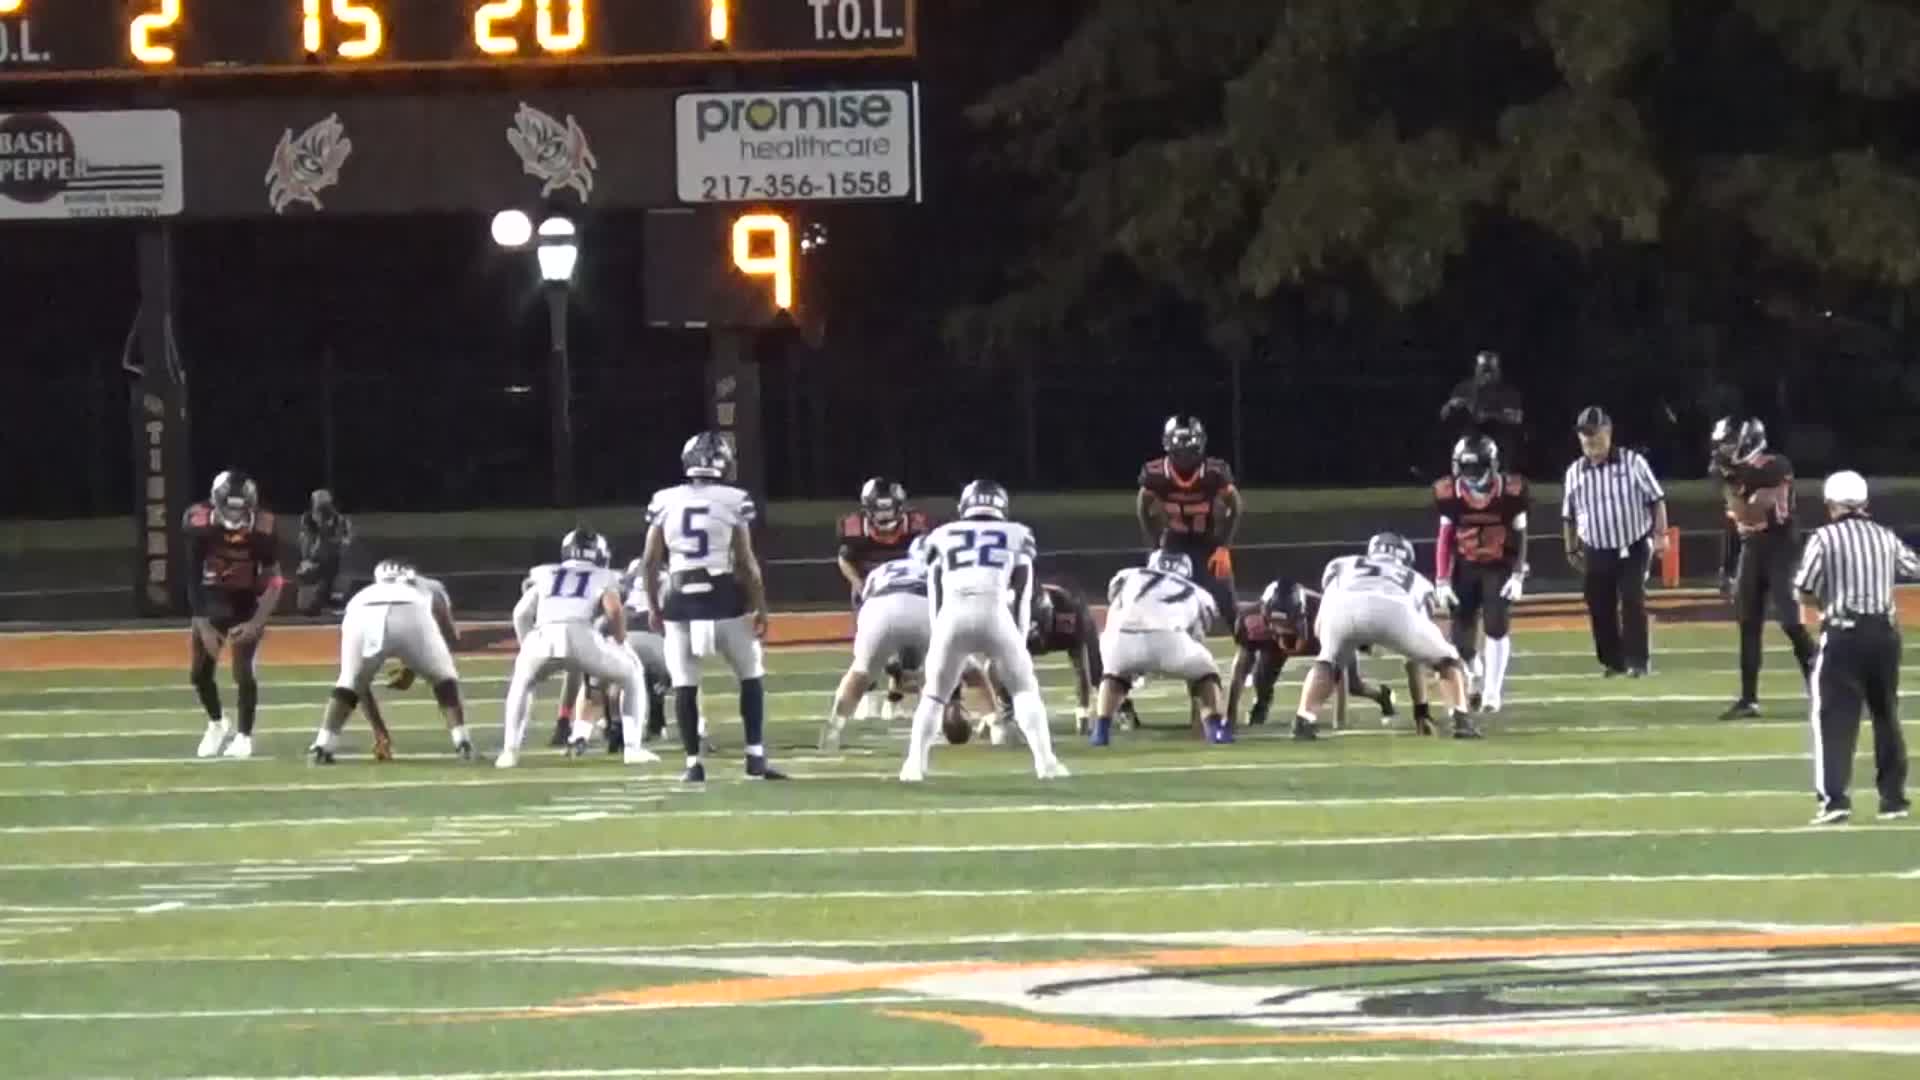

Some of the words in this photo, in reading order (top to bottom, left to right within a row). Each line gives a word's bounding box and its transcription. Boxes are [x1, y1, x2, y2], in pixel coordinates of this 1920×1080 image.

[130, 0, 180, 62] 2
[303, 0, 382, 57] 15
[475, 0, 585, 54] 20
[809, 0, 904, 39] T.O.L.
[696, 94, 892, 143] promise
[739, 135, 890, 161] healthcare
[702, 171, 891, 200] 217-356-1558
[733, 214, 791, 309] 9
[681, 507, 710, 559] 5
[948, 529, 1008, 569] 22
[552, 569, 591, 597] 11
